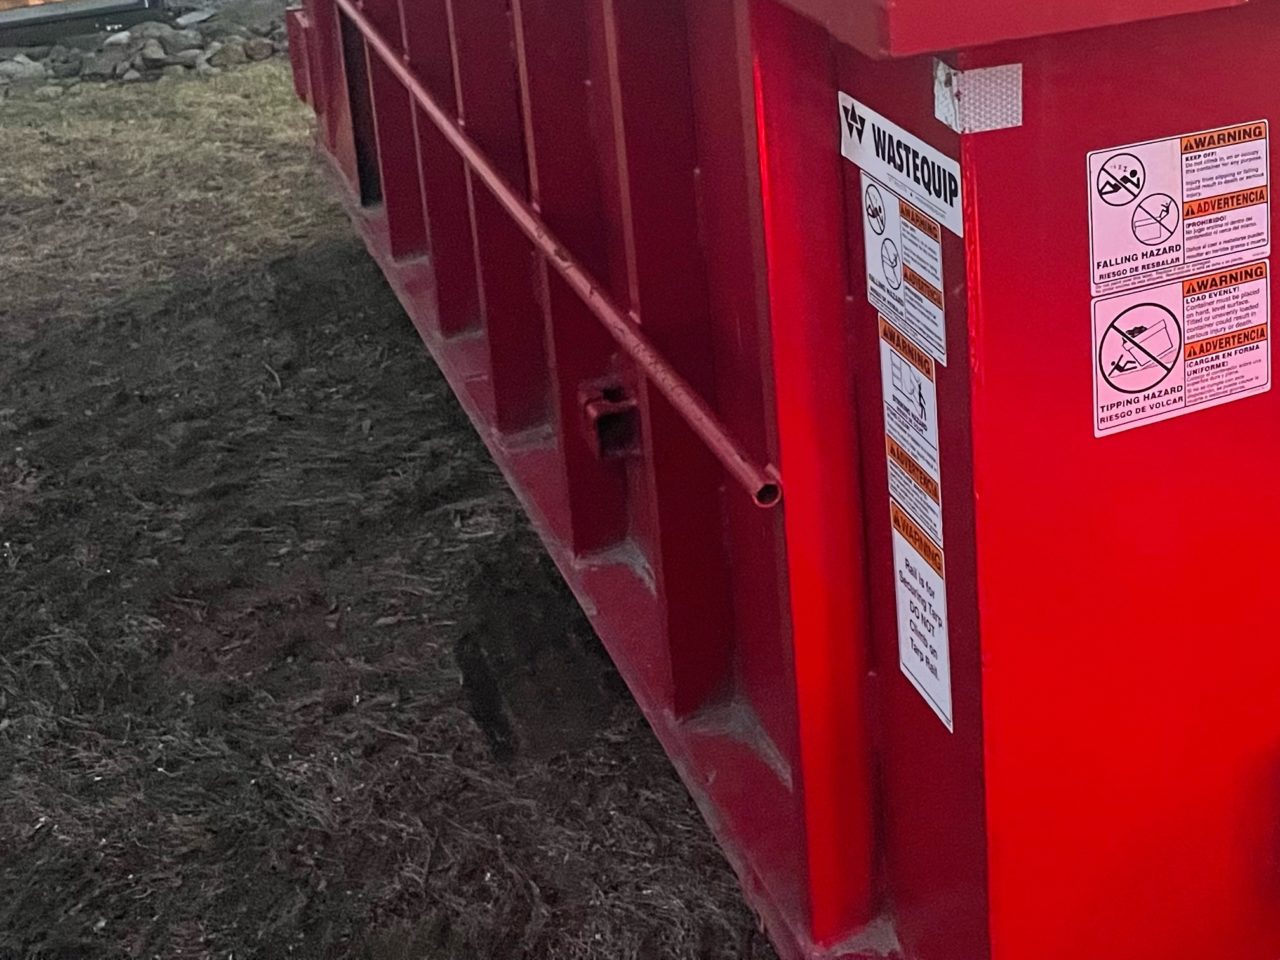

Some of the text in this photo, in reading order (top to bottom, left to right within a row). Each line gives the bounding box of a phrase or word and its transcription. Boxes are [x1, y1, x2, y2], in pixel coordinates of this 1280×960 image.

[1193, 125, 1263, 149] WARNING
[871, 122, 959, 208] WASTEQUIP
[1196, 189, 1266, 214] ADVERTENCIA
[1096, 253, 1139, 270] FALLING
[1141, 244, 1182, 260] HAZARD
[1099, 268, 1128, 281] RIESGO
[1129, 265, 1140, 274] DE
[1141, 256, 1180, 271] RESBALAR
[1196, 266, 1264, 292] WARNING
[1185, 286, 1240, 305] LOAD EVENLY!
[886, 327, 931, 376] WARNING
[1198, 327, 1266, 355] ADVERTENCIA
[1221, 351, 1233, 359] EN
[1234, 344, 1260, 356] FORMA
[1099, 396, 1140, 413] TIPPING
[1143, 384, 1184, 402] HAZARD
[1099, 409, 1133, 424] RIESGO
[1135, 405, 1147, 415] DE
[1148, 395, 1184, 410] VOLCAR
[909, 599, 935, 638] DO NOT
[909, 636, 924, 662] Tarp
